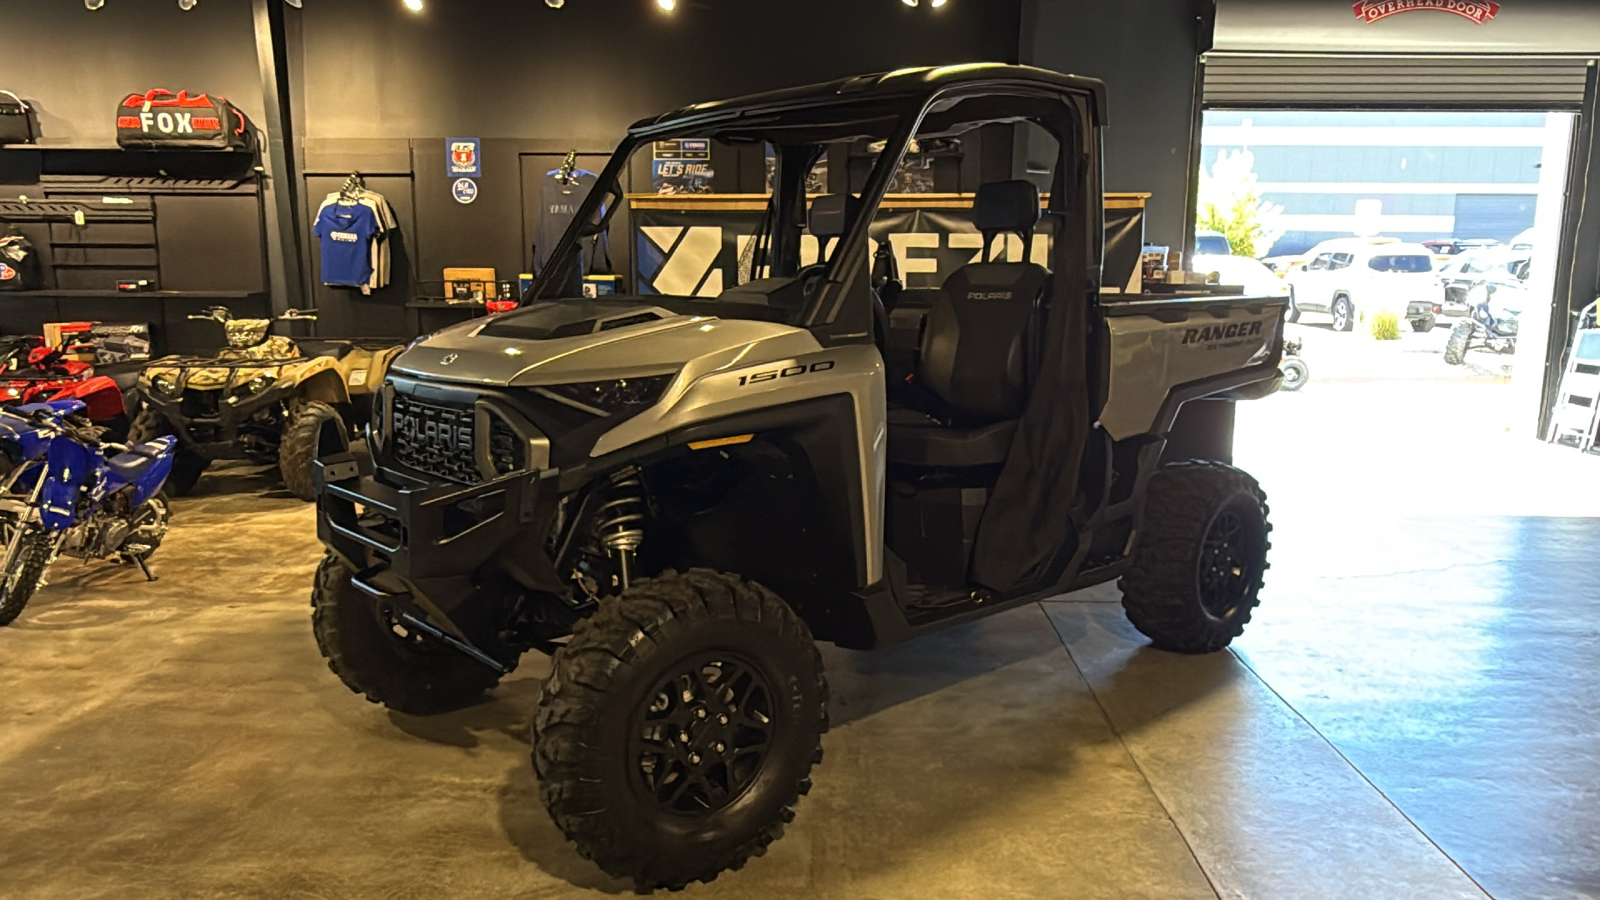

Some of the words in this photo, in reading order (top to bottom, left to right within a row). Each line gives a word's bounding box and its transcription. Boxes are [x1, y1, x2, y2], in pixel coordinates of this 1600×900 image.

[1368, 0, 1444, 18] OVERHEAD
[1447, 0, 1483, 20] DOOR
[139, 112, 193, 134] FOX
[459, 152, 467, 161] 1
[657, 163, 684, 175] LET'S
[685, 163, 708, 175] RIDE
[967, 291, 1013, 301] POLARIS
[1181, 320, 1263, 345] RANGER
[737, 360, 835, 387] 1500
[393, 411, 473, 451] POLARIS
